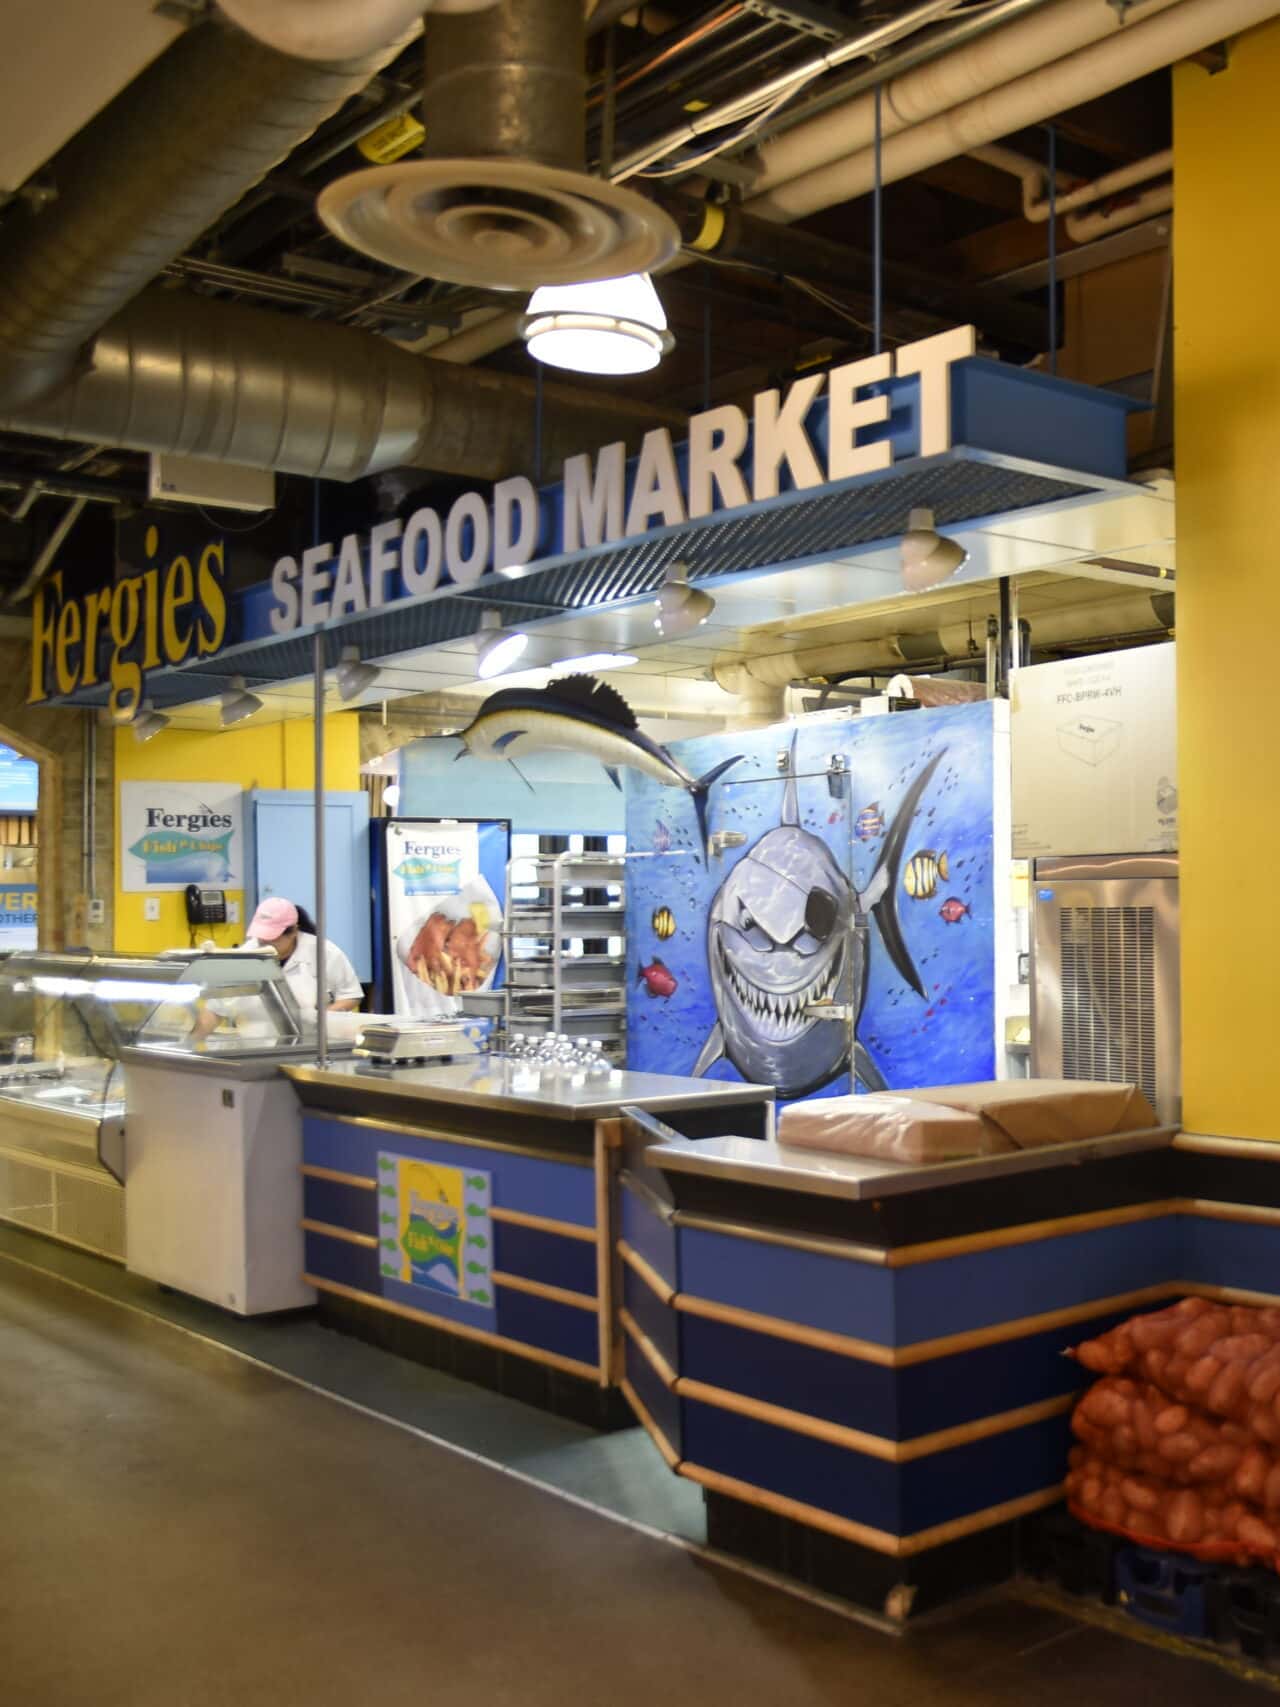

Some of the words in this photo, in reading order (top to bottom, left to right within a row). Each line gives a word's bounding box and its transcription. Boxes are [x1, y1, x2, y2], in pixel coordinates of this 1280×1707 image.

[28, 526, 228, 722] Fergies
[268, 475, 541, 636] SEAFOOD
[563, 324, 976, 546] MARKET
[145, 806, 232, 833] Fergies
[404, 840, 462, 858] Fergies
